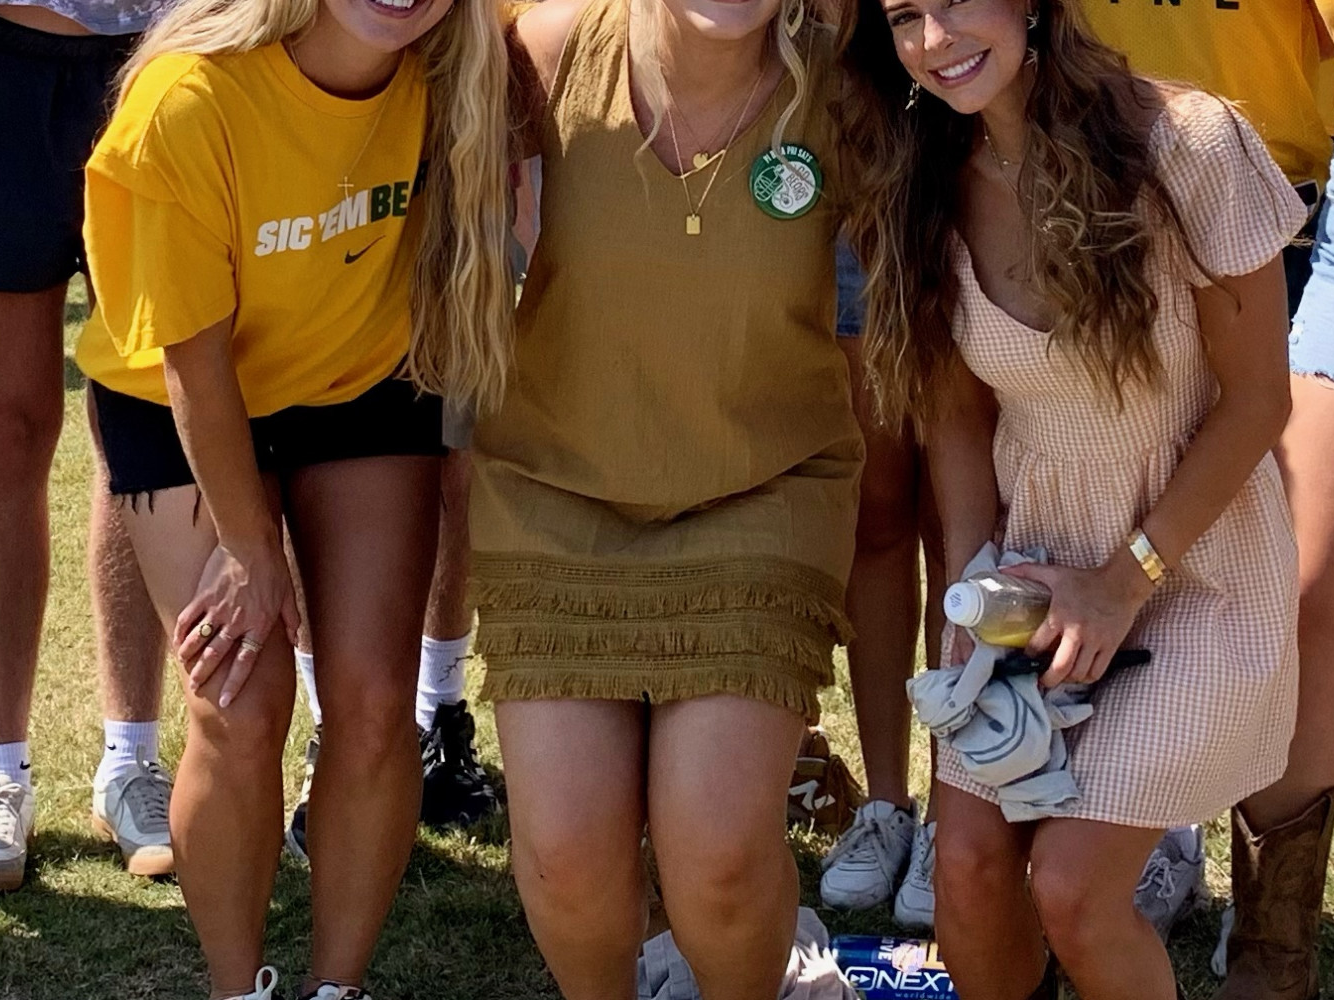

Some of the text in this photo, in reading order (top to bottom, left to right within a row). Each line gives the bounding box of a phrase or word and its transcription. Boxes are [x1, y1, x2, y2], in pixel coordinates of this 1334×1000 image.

[254, 216, 315, 257] SIC
[318, 189, 369, 243] 'EM
[895, 991, 952, 1000] worldwide
